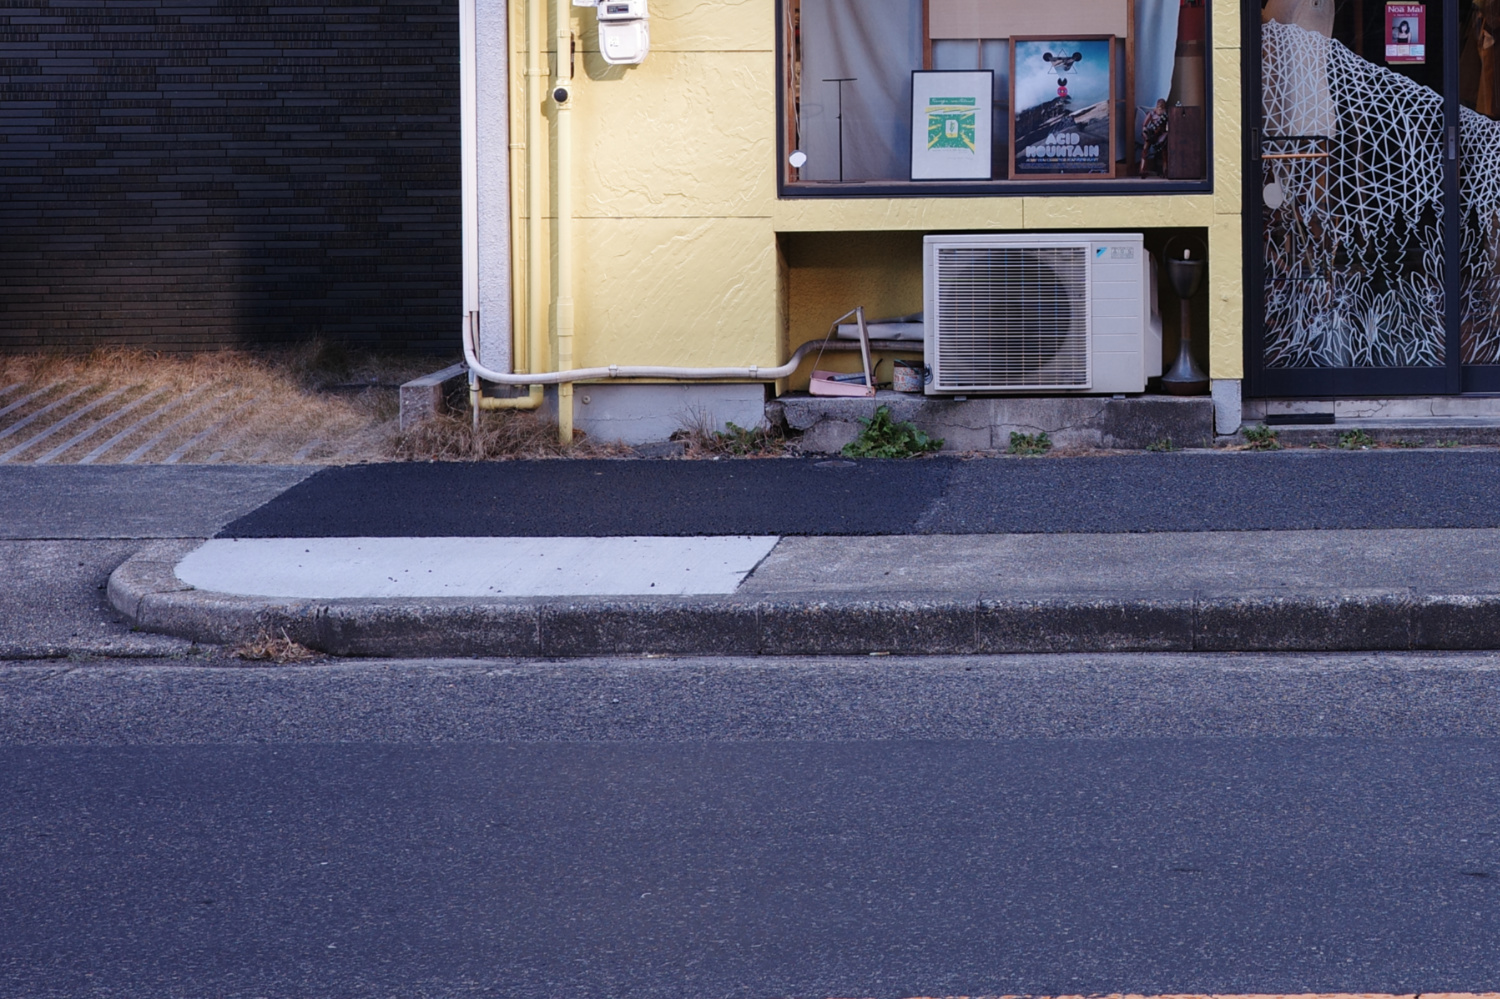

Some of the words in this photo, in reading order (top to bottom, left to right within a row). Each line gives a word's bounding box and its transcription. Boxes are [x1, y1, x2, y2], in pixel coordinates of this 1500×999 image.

[1387, 5, 1404, 13] Noa
[1045, 132, 1080, 145] ACID
[1025, 145, 1099, 157] MOUNTAIN
